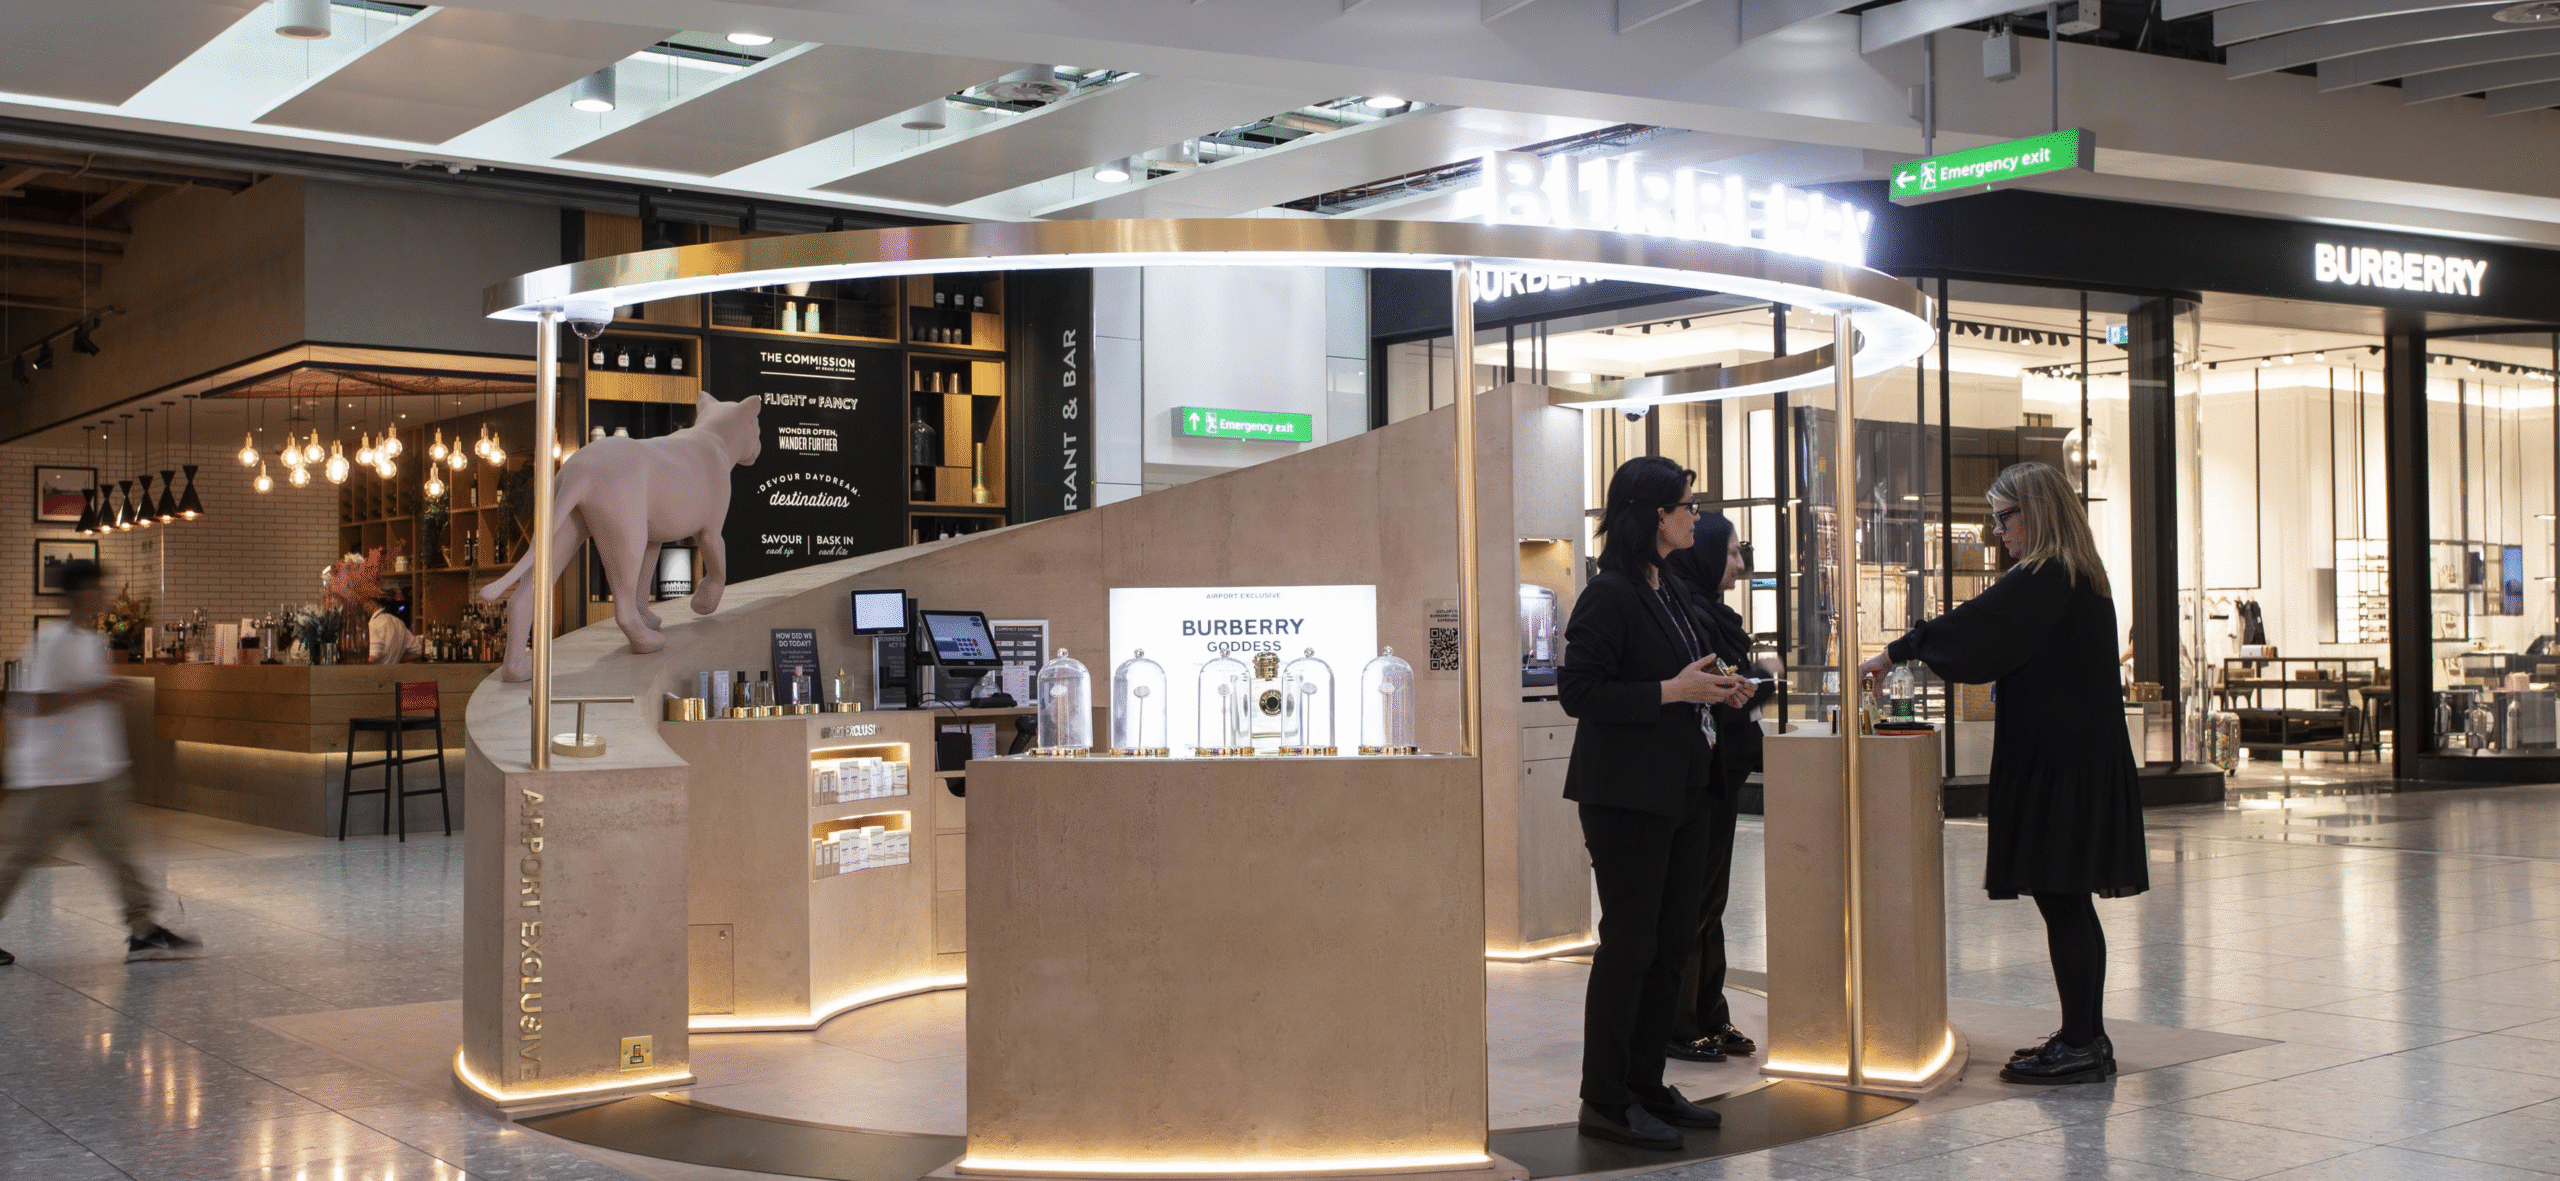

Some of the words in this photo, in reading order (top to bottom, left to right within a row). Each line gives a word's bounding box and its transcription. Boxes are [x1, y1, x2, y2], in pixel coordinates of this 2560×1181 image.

[1939, 155, 2019, 181] Emergency
[2021, 147, 2052, 166] exit
[1483, 150, 1874, 268] BURBERRY
[2314, 242, 2488, 297] BURBERRY
[760, 351, 782, 363] THE
[784, 353, 856, 368] COMMISSION
[1063, 329, 1077, 388] BAR
[763, 392, 807, 407] FLIGHT
[818, 395, 858, 411] FANCY
[1062, 397, 1078, 420] &
[778, 427, 812, 435] WONDER
[812, 428, 838, 437] OFTEN,
[1219, 418, 1273, 434] Emergency
[1275, 421, 1295, 433] exit
[778, 435, 807, 450] WANDER
[808, 437, 838, 452] FURTHER
[759, 472, 800, 493] DEVOUR
[805, 472, 859, 496] DAYDREAM
[769, 490, 850, 508] destinations
[761, 534, 802, 544] SAVOUR
[816, 535, 841, 545] BASK
[843, 536, 854, 545] IN
[765, 545, 783, 555] each
[783, 548, 795, 558] sip
[818, 546, 835, 556] each
[835, 546, 849, 556] bite
[1182, 618, 1305, 636] BURBERRY
[1207, 640, 1282, 652] GODDESS
[521, 788, 545, 913] AIRPORT
[519, 919, 543, 1082] EXCLUSIVE
